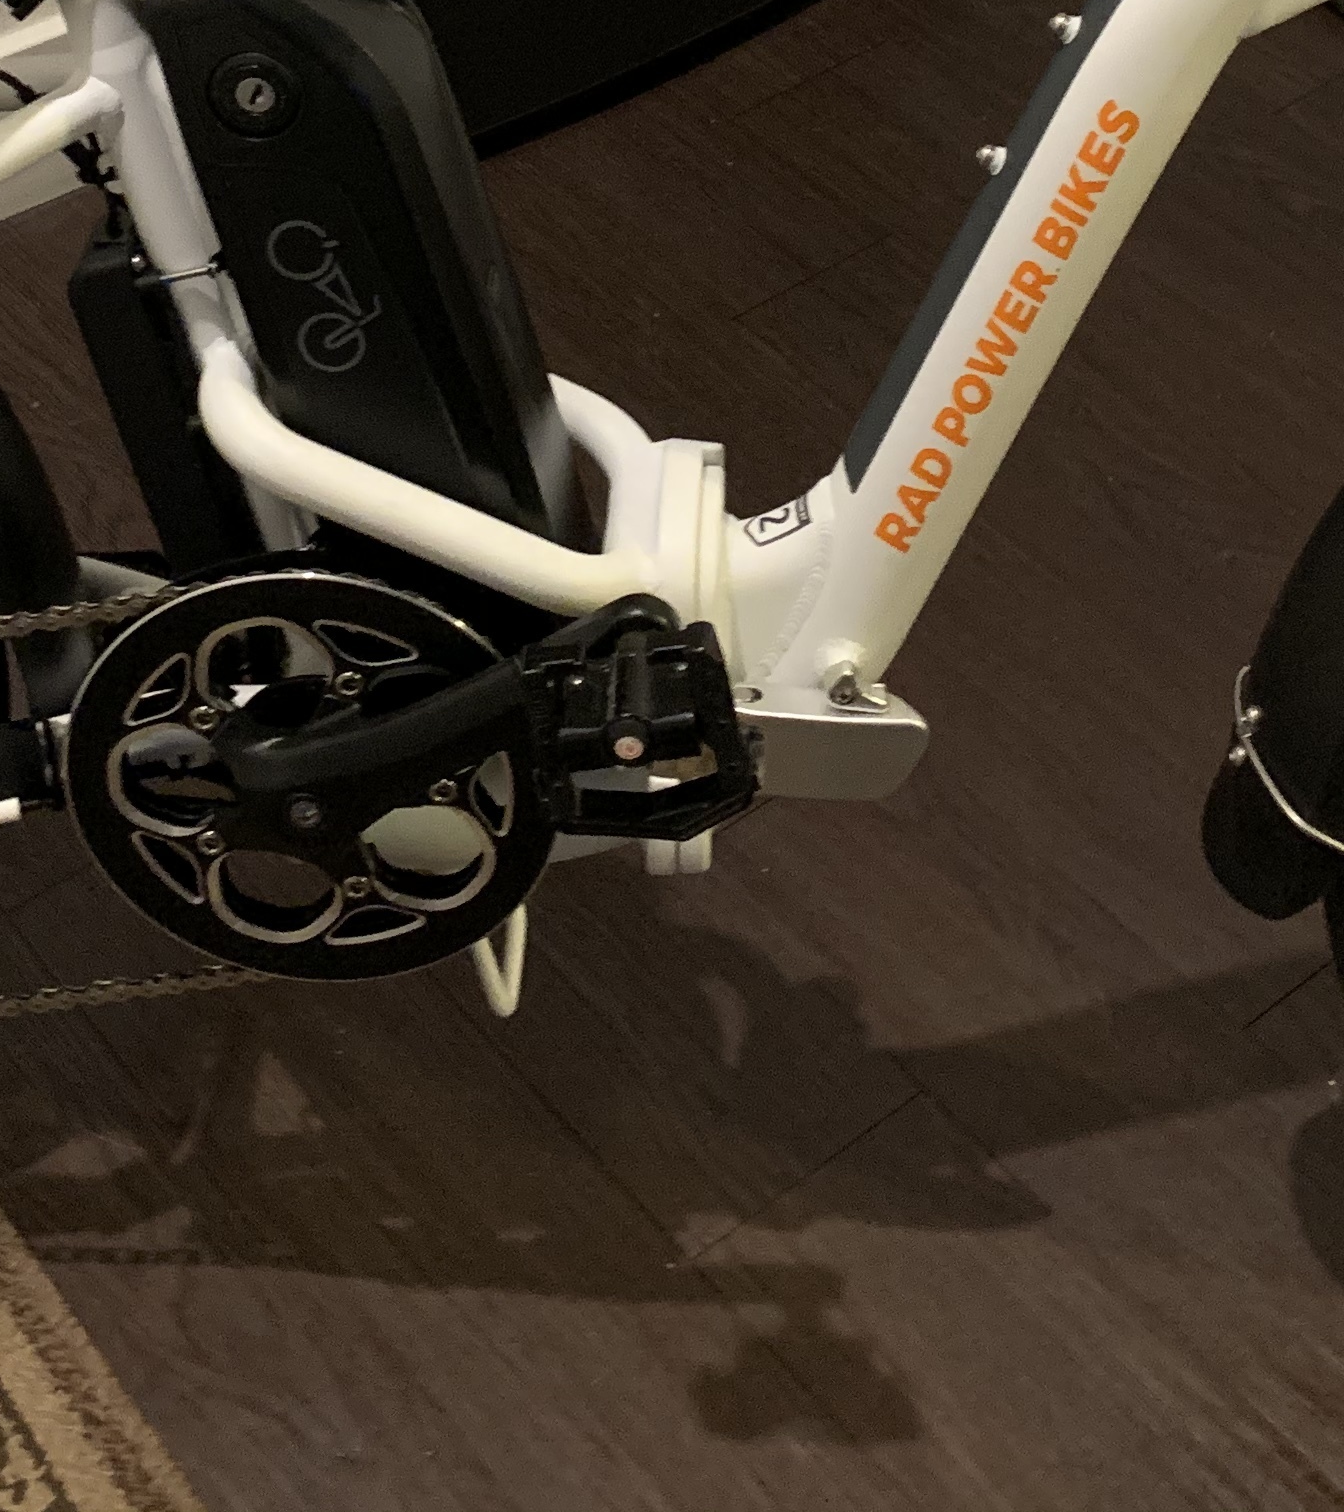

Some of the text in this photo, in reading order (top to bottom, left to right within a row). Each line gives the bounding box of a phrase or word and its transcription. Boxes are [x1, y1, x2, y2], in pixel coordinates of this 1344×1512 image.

[874, 100, 1141, 553] RAD POWER BIKES
